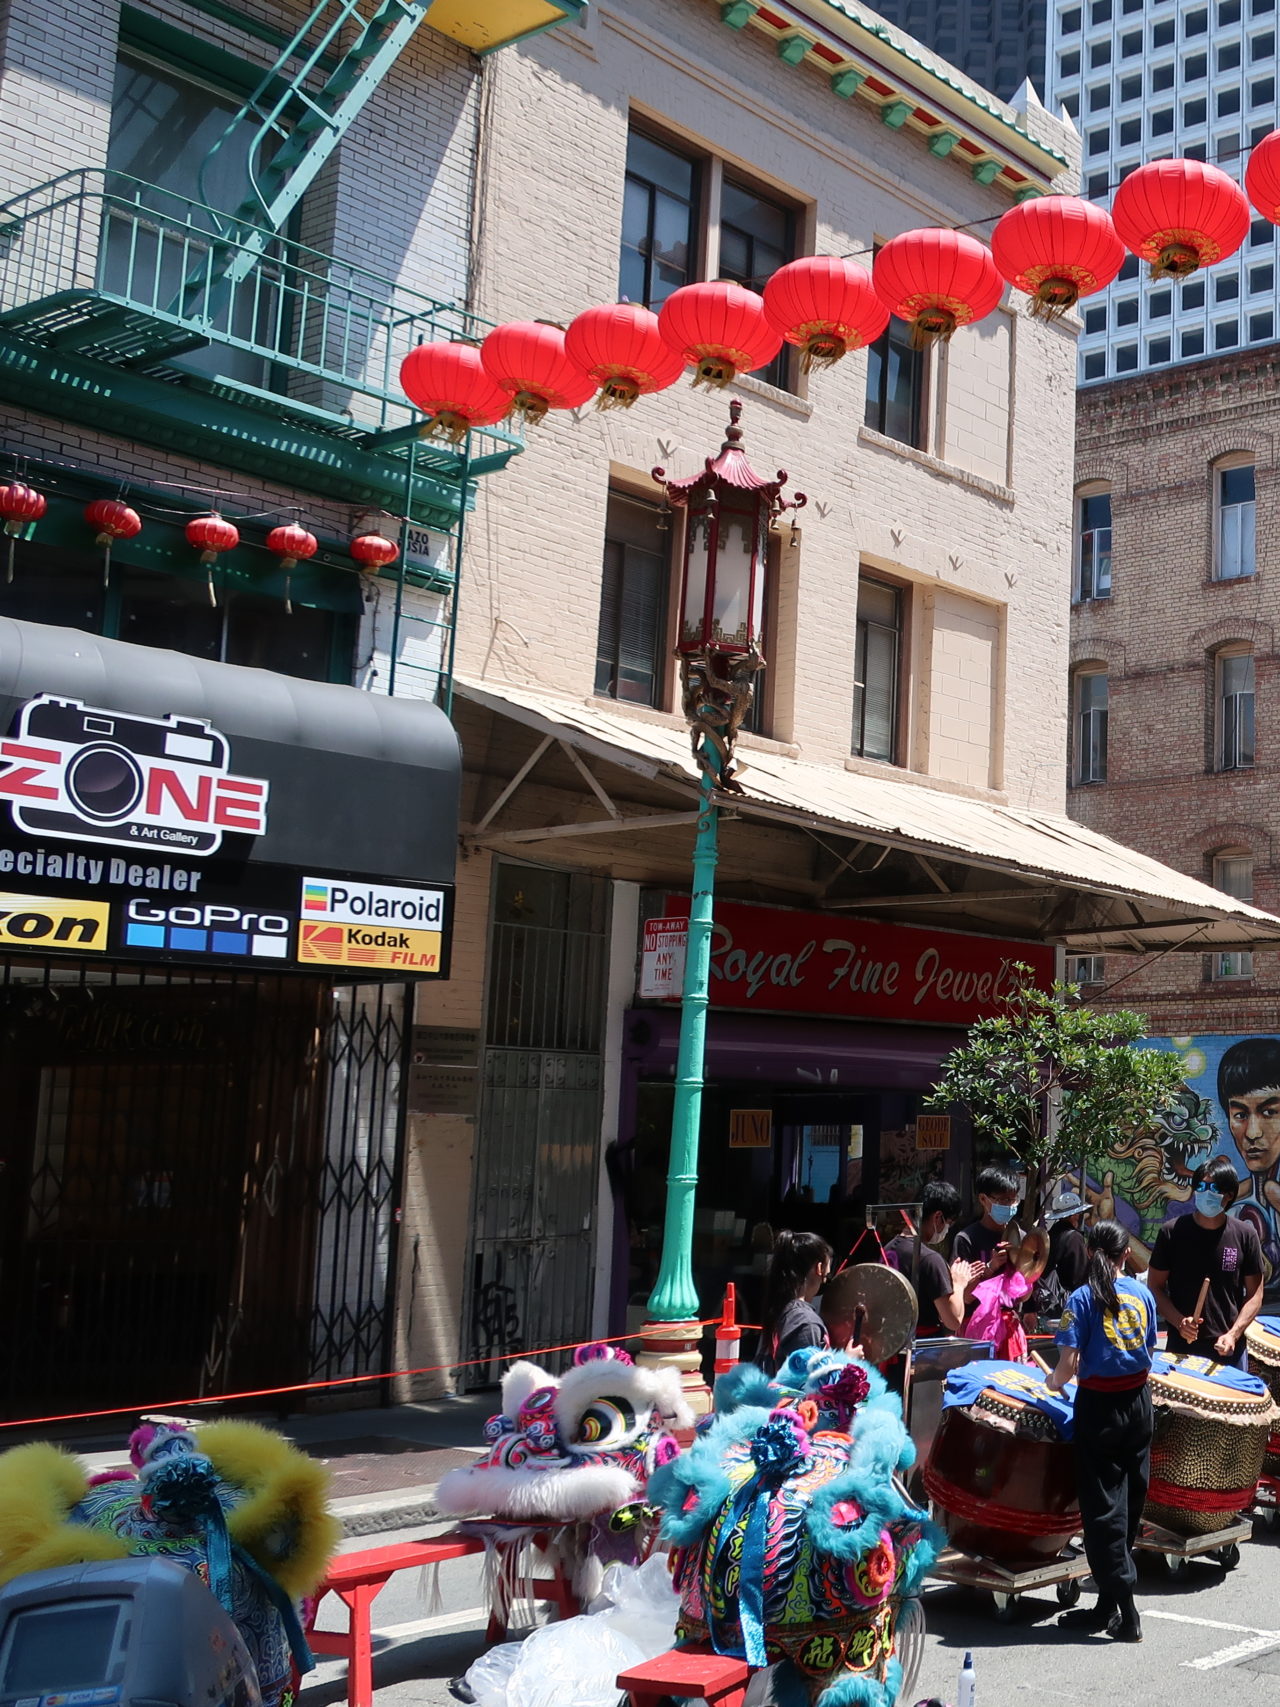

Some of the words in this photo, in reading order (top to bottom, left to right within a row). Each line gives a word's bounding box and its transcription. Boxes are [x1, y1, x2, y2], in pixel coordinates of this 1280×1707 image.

[130, 826, 138, 836] &
[141, 827, 158, 839] Art
[161, 832, 198, 846] Gallery
[109, 858, 201, 893] Dealer
[330, 887, 441, 922] Polaroid
[128, 898, 290, 934] GoPro
[649, 920, 685, 932] TOW-AWAY
[347, 928, 410, 949] Kodak
[644, 934, 656, 951] NO
[390, 951, 436, 967] FILM
[656, 952, 673, 965] ANY
[822, 938, 900, 996] Fine
[654, 968, 673, 981] TIME
[732, 1115, 770, 1143] JUNO
[922, 1136, 943, 1148] SALE
[804, 1637, 834, 1668] 龍
